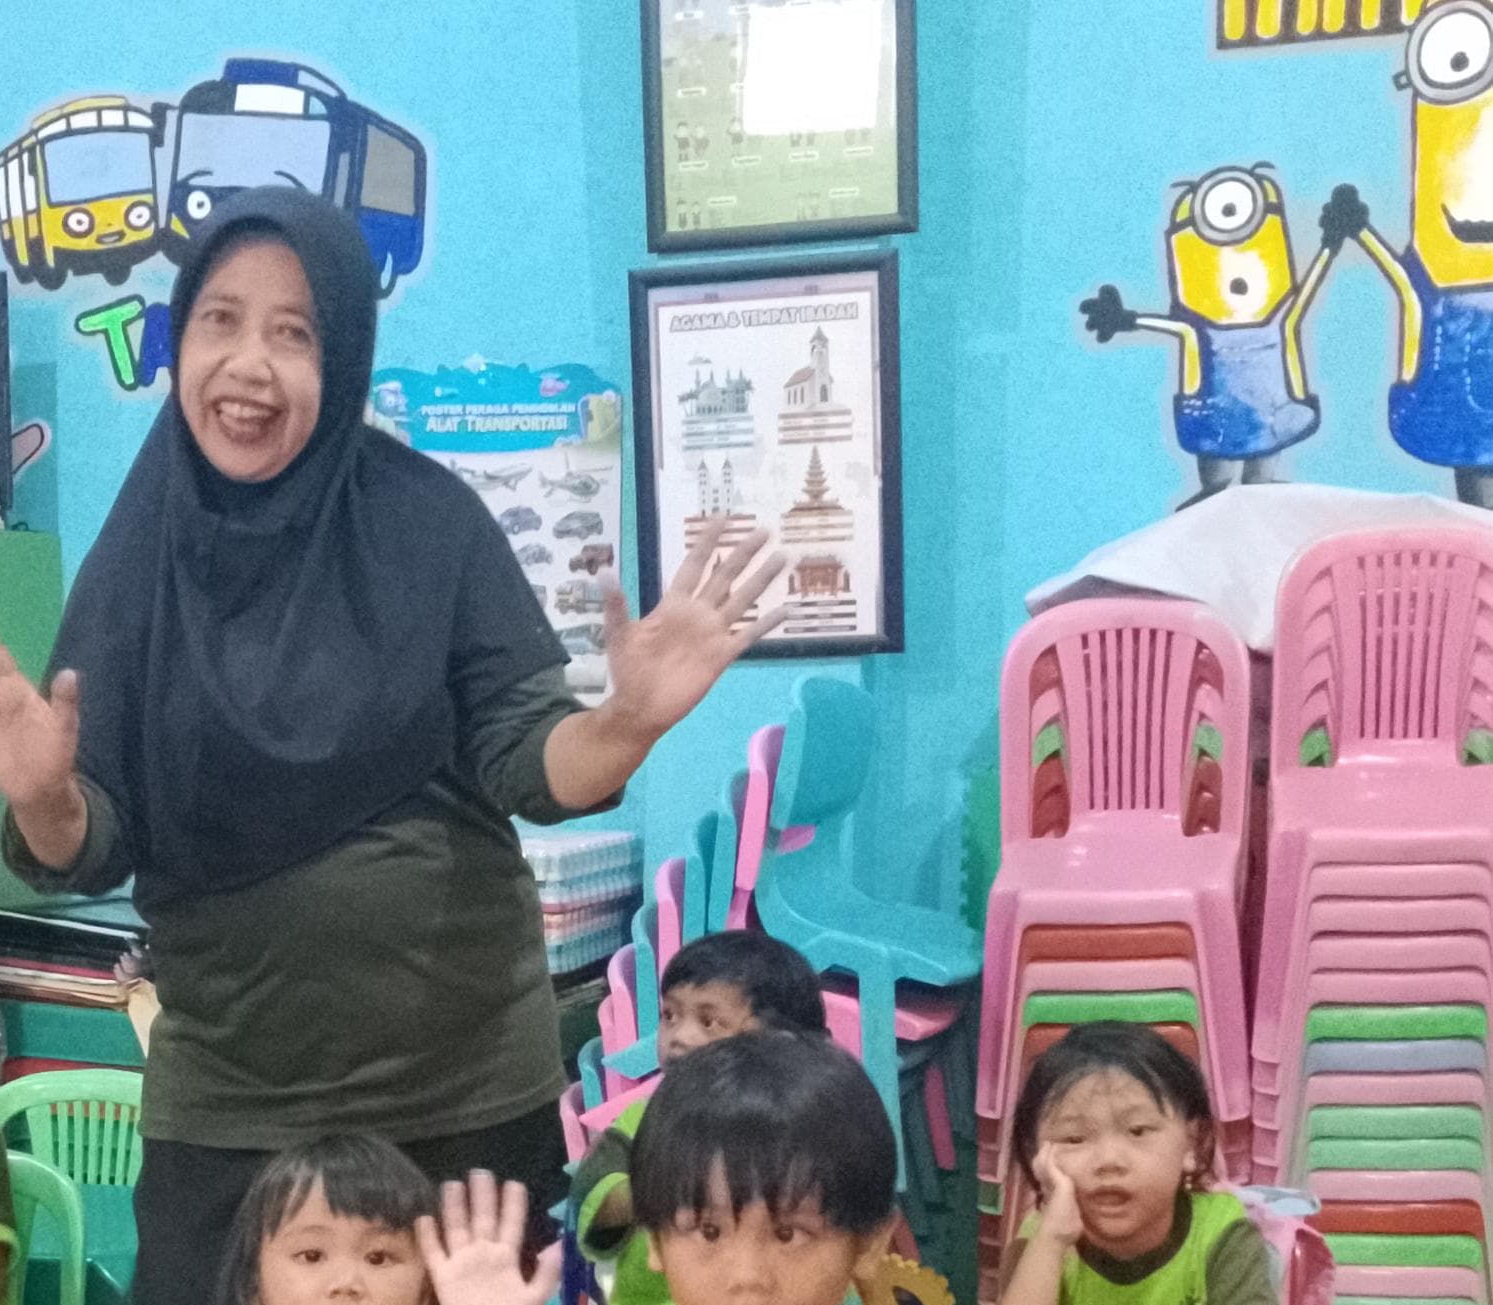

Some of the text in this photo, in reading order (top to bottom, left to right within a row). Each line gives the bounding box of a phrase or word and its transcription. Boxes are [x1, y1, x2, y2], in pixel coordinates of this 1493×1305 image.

[670, 312, 726, 332] AGAMA
[741, 307, 799, 327] TEMPAT
[799, 302, 858, 323] IBADAH
[426, 414, 568, 432] ALAT TRANSPORTASI
